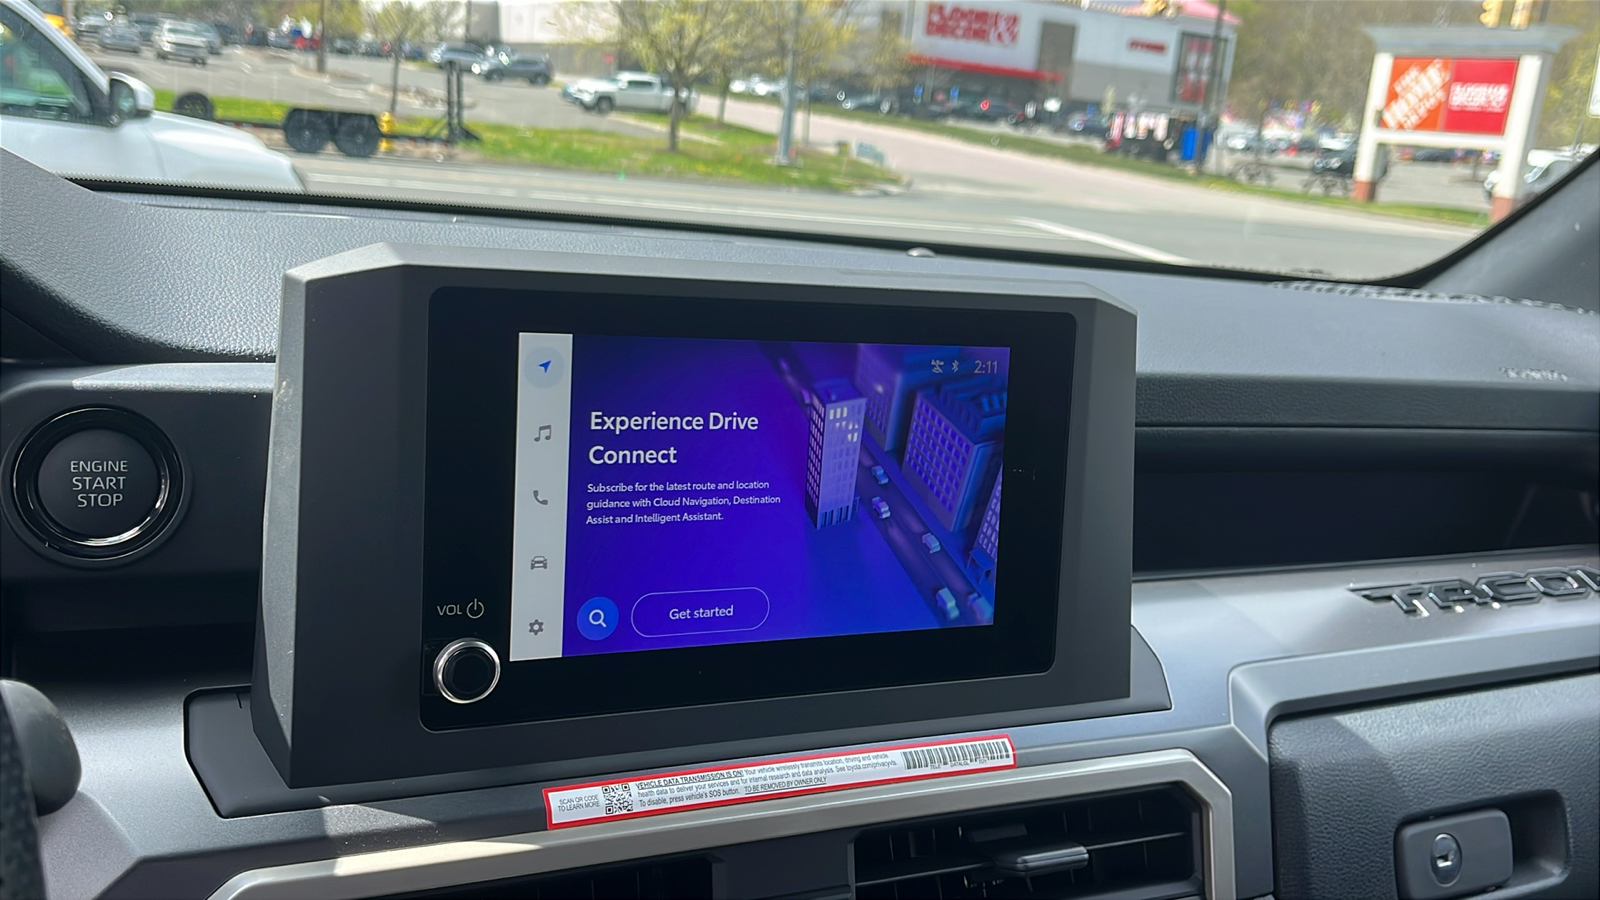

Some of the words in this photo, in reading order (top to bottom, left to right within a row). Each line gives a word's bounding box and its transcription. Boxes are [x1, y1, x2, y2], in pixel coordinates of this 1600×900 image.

[974, 360, 998, 374] 2:11
[590, 411, 704, 435] Experience
[709, 412, 759, 430] Drive
[588, 446, 677, 464] Connect
[70, 461, 128, 472] ENGINE
[72, 476, 126, 490] START
[587, 483, 633, 493] Subscribe
[635, 482, 648, 491] for
[649, 482, 664, 491] the
[666, 482, 691, 491] latest
[692, 482, 716, 490] route
[717, 481, 734, 490] and
[736, 481, 769, 489] location
[78, 494, 123, 507] STOP
[586, 499, 630, 510] guidance
[632, 498, 651, 507] with
[653, 497, 680, 506] Cloud
[682, 496, 732, 507] Navigation,
[733, 496, 781, 505] Destination
[586, 515, 613, 524] Assist
[615, 514, 633, 523] and
[635, 513, 681, 524] Intelligent
[682, 512, 724, 522] Assistant.
[437, 604, 462, 616] VOL
[669, 608, 691, 620] Get
[693, 605, 734, 618] started
[635, 780, 663, 790] VEHICLE
[663, 777, 680, 786] DATA
[682, 772, 725, 785] TRANSMISSION
[725, 771, 732, 779] IS
[757, 766, 775, 774] vehicle
[776, 763, 799, 772] wirelessly
[800, 760, 823, 769] transmits
[845, 755, 861, 763] driving
[871, 752, 889, 760] vehicle
[638, 788, 655, 797] health
[656, 787, 668, 795] data
[669, 786, 675, 794] to
[676, 784, 694, 793] deliver
[695, 782, 707, 792] your
[707, 780, 729, 789] services
[730, 777, 740, 786] and
[740, 777, 748, 785] for
[749, 774, 768, 783] internal
[768, 771, 790, 781] research
[801, 768, 813, 776] data
[835, 765, 846, 773] See
[639, 799, 646, 807] To
[647, 796, 669, 807] disable,
[669, 795, 685, 805] press
[685, 791, 708, 802] vehicle's
[708, 789, 722, 798] SOS
[744, 785, 751, 793] TO
[752, 784, 760, 792] BE
[760, 780, 786, 791] REMOVED
[786, 780, 793, 788] BY
[794, 777, 813, 787] OWNER
[813, 776, 827, 785] ONLY
[558, 804, 566, 812] TO
[566, 802, 584, 811] LEARN
[584, 800, 600, 809] MORE
[559, 797, 575, 805] SCAN
[583, 794, 599, 802] CODE
